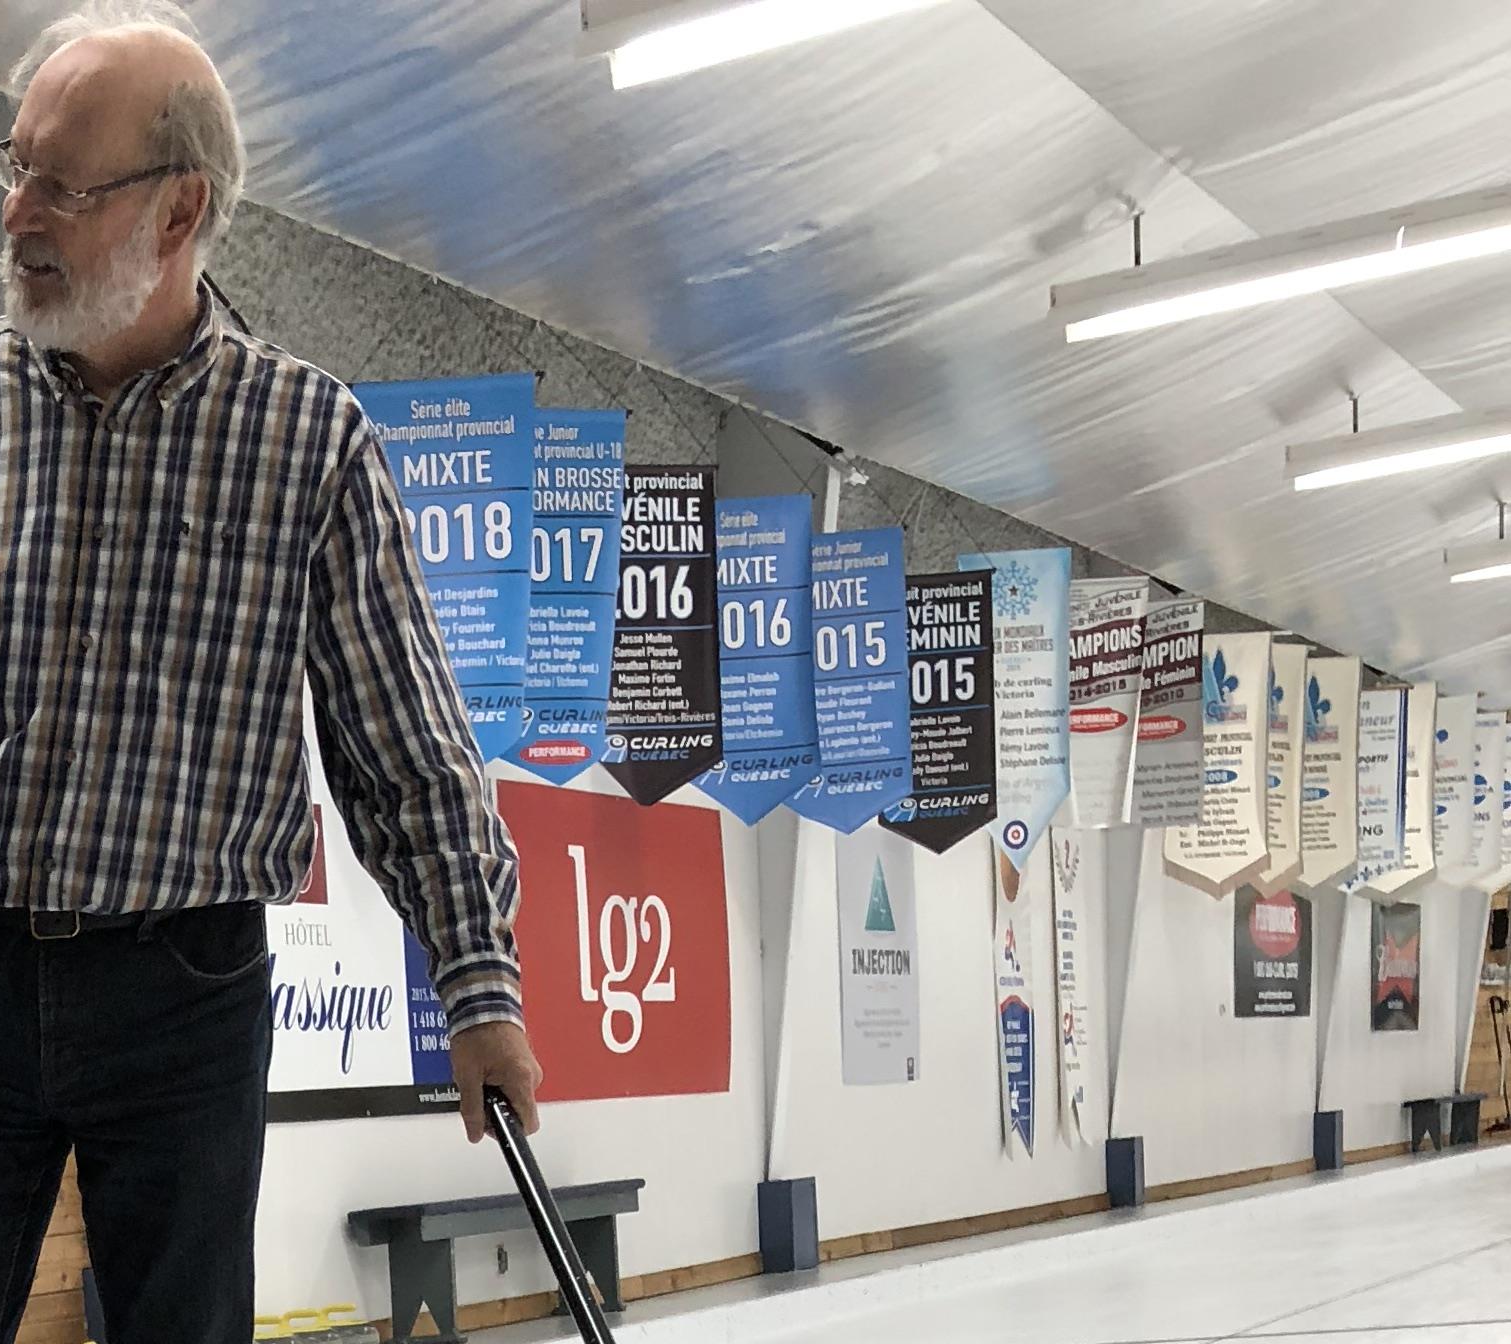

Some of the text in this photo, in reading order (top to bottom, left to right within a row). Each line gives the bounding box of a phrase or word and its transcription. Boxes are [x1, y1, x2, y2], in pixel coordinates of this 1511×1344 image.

[411, 398, 471, 419] Série élite
[376, 415, 515, 445] Championnat provincial
[548, 424, 579, 441] Junior
[403, 449, 492, 488] MIXTE
[555, 467, 622, 490] BROSSE
[633, 473, 704, 494] provincial
[533, 491, 615, 512] ORMANCE
[621, 491, 701, 522] VÉNILE
[621, 525, 704, 552] SCULIN
[531, 527, 604, 582] 017
[616, 565, 694, 620] 016
[922, 581, 983, 601] provincial
[722, 598, 791, 650] 016
[908, 601, 981, 626] VÉNILE
[453, 622, 496, 634] Fournier
[458, 637, 506, 650] Bouchard
[816, 621, 887, 672] 015
[1070, 625, 1142, 660] AMPIONS
[1142, 634, 1199, 670] MPION
[450, 656, 488, 669] chemin
[1092, 654, 1143, 677] Masculin
[912, 657, 975, 704] 015
[1154, 667, 1196, 686] Féminin
[528, 747, 586, 758] PERFORMANCE
[630, 735, 713, 749] CURLING
[1204, 746, 1242, 755] SCULIN
[731, 755, 814, 770] CURLING
[827, 767, 903, 784] CURLING
[919, 794, 990, 809] CURLING
[284, 918, 332, 947] HÔTEL
[567, 845, 676, 1054] lg2
[851, 949, 911, 976] INJECTION
[419, 1011, 436, 1028] 418
[421, 1035, 437, 1051] 800
[439, 1034, 450, 1051] 46
